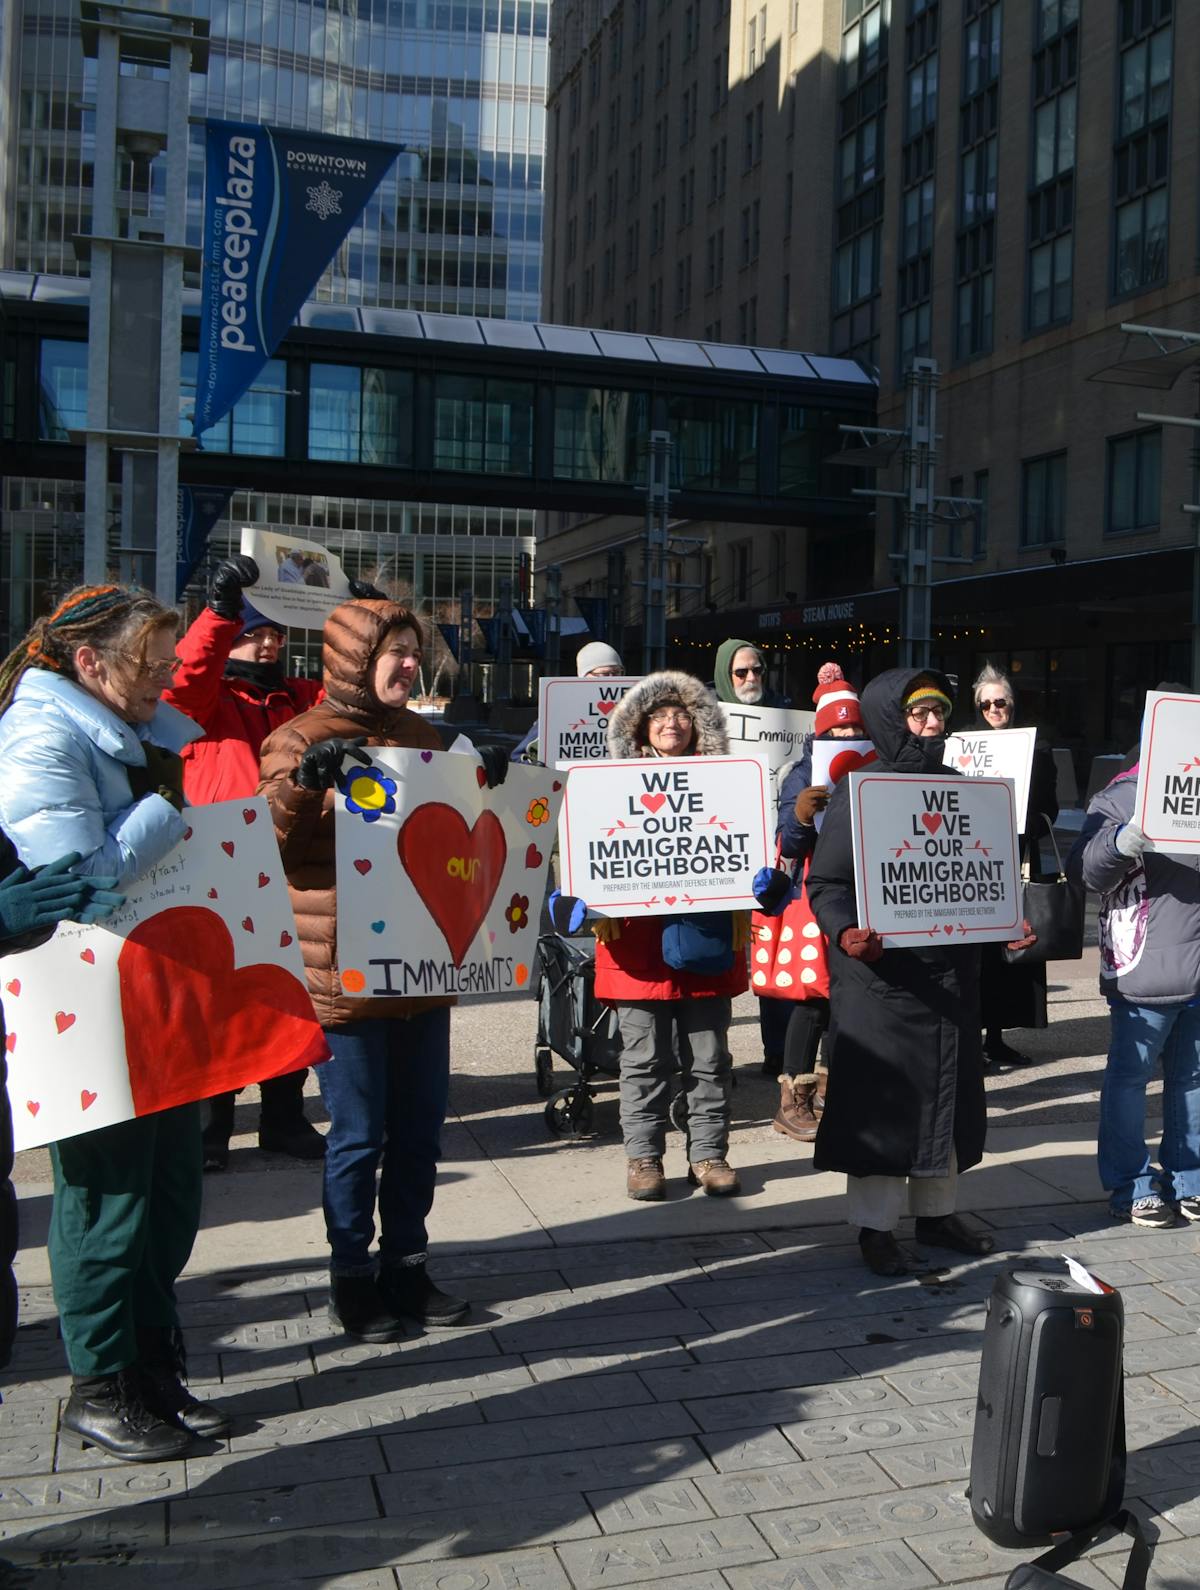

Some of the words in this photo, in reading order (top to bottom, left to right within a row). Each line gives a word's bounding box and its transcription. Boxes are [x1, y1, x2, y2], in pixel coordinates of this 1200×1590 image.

[287, 150, 367, 171] DOWNTOWN
[216, 136, 258, 352] peaceplaza
[803, 606, 826, 623] STEAK
[828, 602, 855, 620] HOUSE
[961, 740, 988, 755] WE
[641, 771, 690, 792] WE
[922, 790, 960, 812] WE
[642, 816, 693, 834] OUR
[588, 833, 750, 860] IMMIGRANT
[924, 838, 964, 857] OUR
[447, 857, 481, 884] our
[590, 854, 751, 880] NEIGHBORS!
[880, 860, 1005, 884] IMMIGRANT
[882, 882, 1006, 905] NEIGHBORS!
[369, 957, 513, 995] IMMIGRANTS
